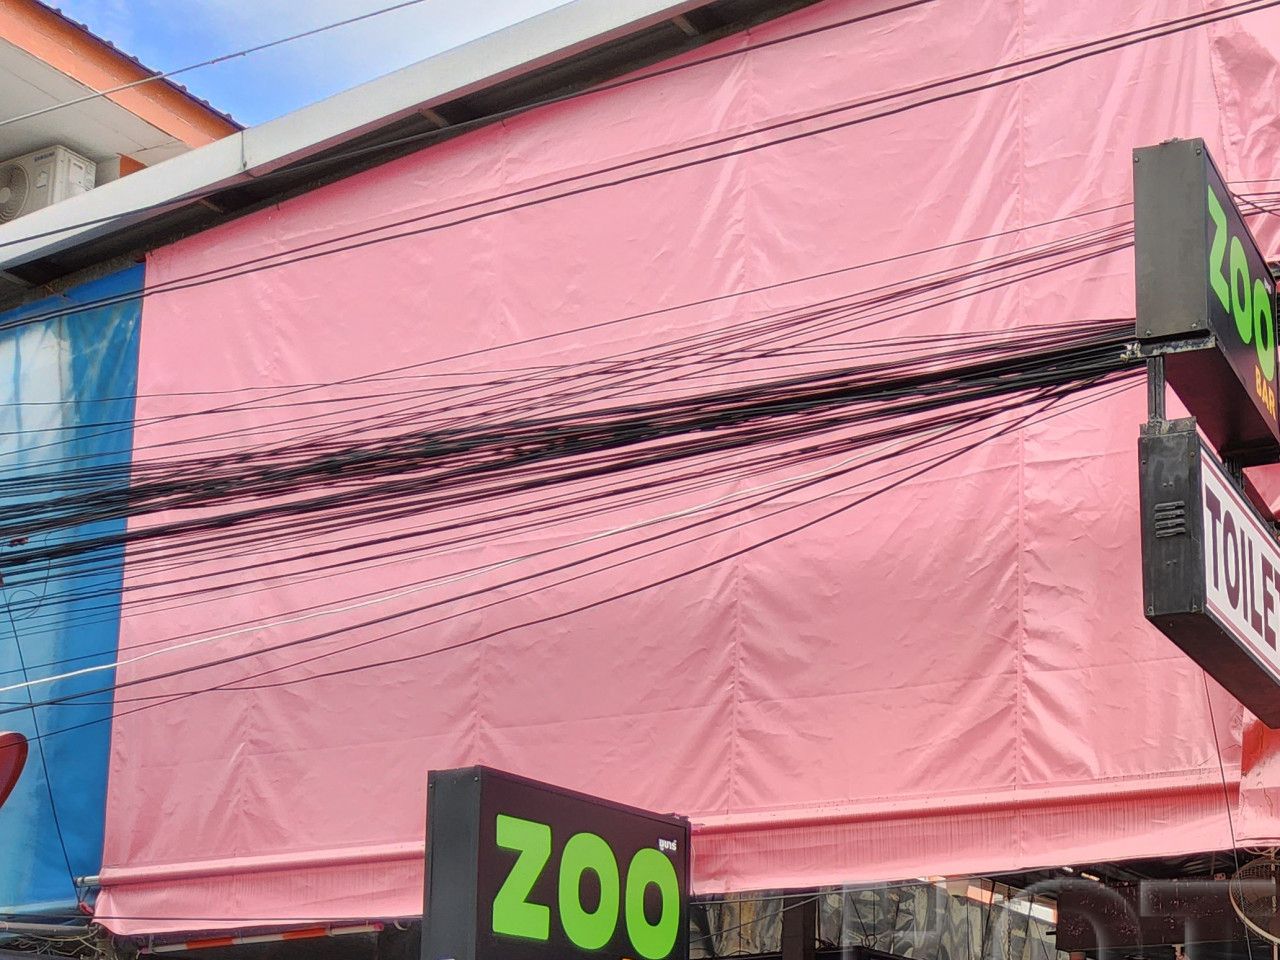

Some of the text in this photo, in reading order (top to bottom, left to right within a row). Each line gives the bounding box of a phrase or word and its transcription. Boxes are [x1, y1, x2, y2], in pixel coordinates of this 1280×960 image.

[1207, 185, 1275, 381] ZOO
[1255, 365, 1277, 420] BAR
[491, 813, 681, 960] ZOO
